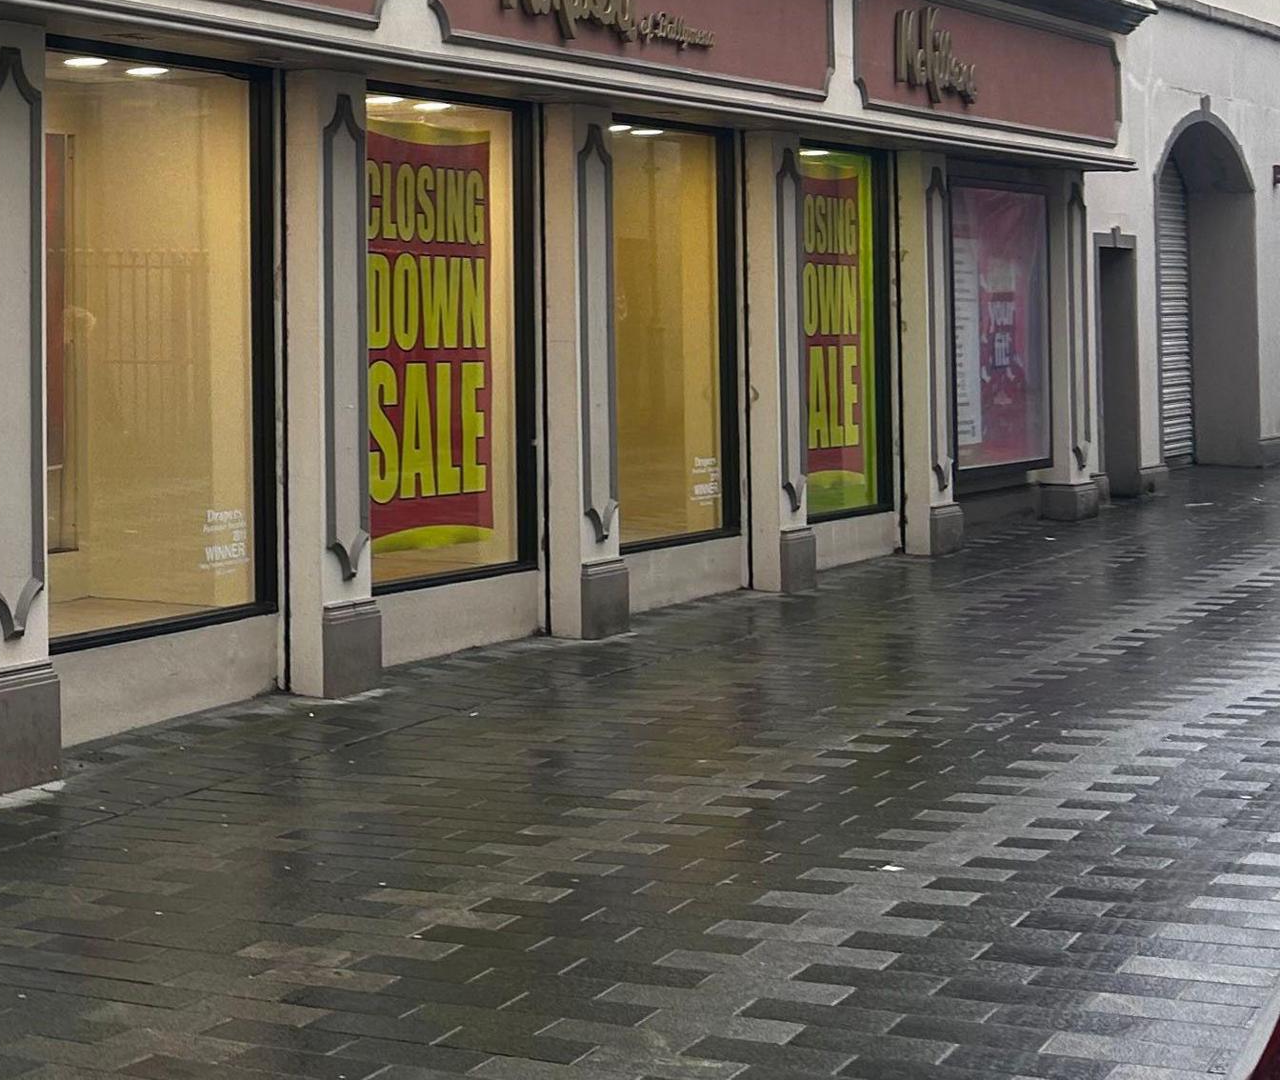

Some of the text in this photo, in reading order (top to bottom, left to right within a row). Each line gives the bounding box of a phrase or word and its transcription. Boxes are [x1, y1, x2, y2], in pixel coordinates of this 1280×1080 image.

[366, 159, 485, 246] CLOSING
[802, 192, 858, 256] OSING
[368, 251, 486, 352] DOWN
[802, 261, 858, 338] OWN
[368, 360, 488, 505] SALE
[807, 345, 860, 450] ALE
[205, 542, 246, 562] WINNER
